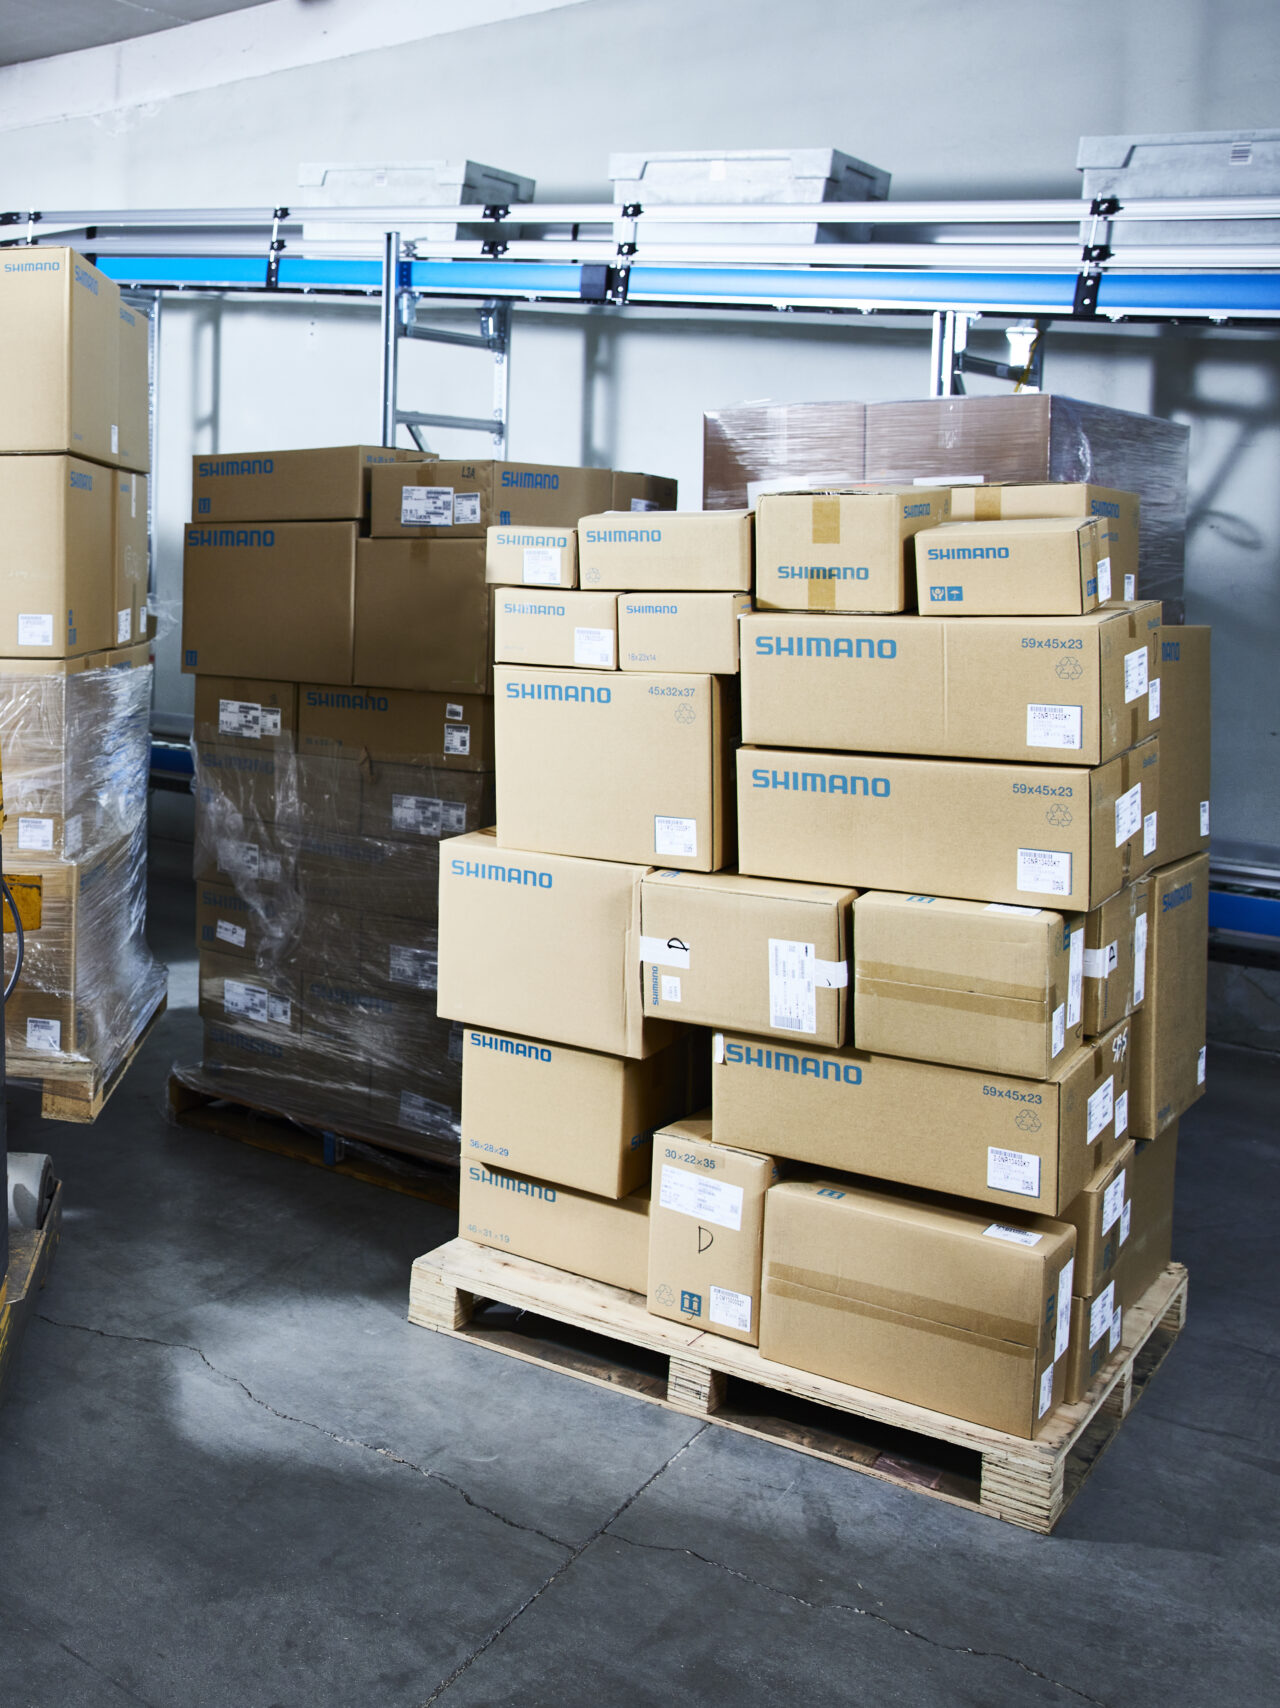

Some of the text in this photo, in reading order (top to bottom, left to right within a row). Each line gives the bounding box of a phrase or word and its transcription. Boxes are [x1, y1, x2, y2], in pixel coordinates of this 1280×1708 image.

[3, 261, 61, 273] SHIMANO
[199, 458, 274, 478] SHIMANO
[501, 471, 559, 490] SHIMANO
[1090, 499, 1120, 519] SHIMANO
[187, 529, 275, 547] SHIMANO
[495, 534, 568, 548] SHIMANO
[586, 529, 662, 543] SHIMANO
[927, 546, 1010, 561] SHIMANO
[777, 565, 870, 581] SHIMANO
[503, 603, 566, 617] SHIMANO
[626, 605, 678, 615] SHIMANO
[755, 635, 1083, 659] SHIMANO 59x45x23
[306, 691, 389, 712] SHIMANO
[506, 682, 696, 704] SHIMANO 45x32x37
[751, 768, 1073, 798] SHIMANO 59x45x23
[451, 859, 553, 889] SHIMANO
[651, 965, 659, 1006] SHIMANO
[470, 1032, 552, 1063] SHIMANO
[725, 1043, 1044, 1105] SHIMANO 59x45x23
[469, 1167, 557, 1203] SHIMANO
